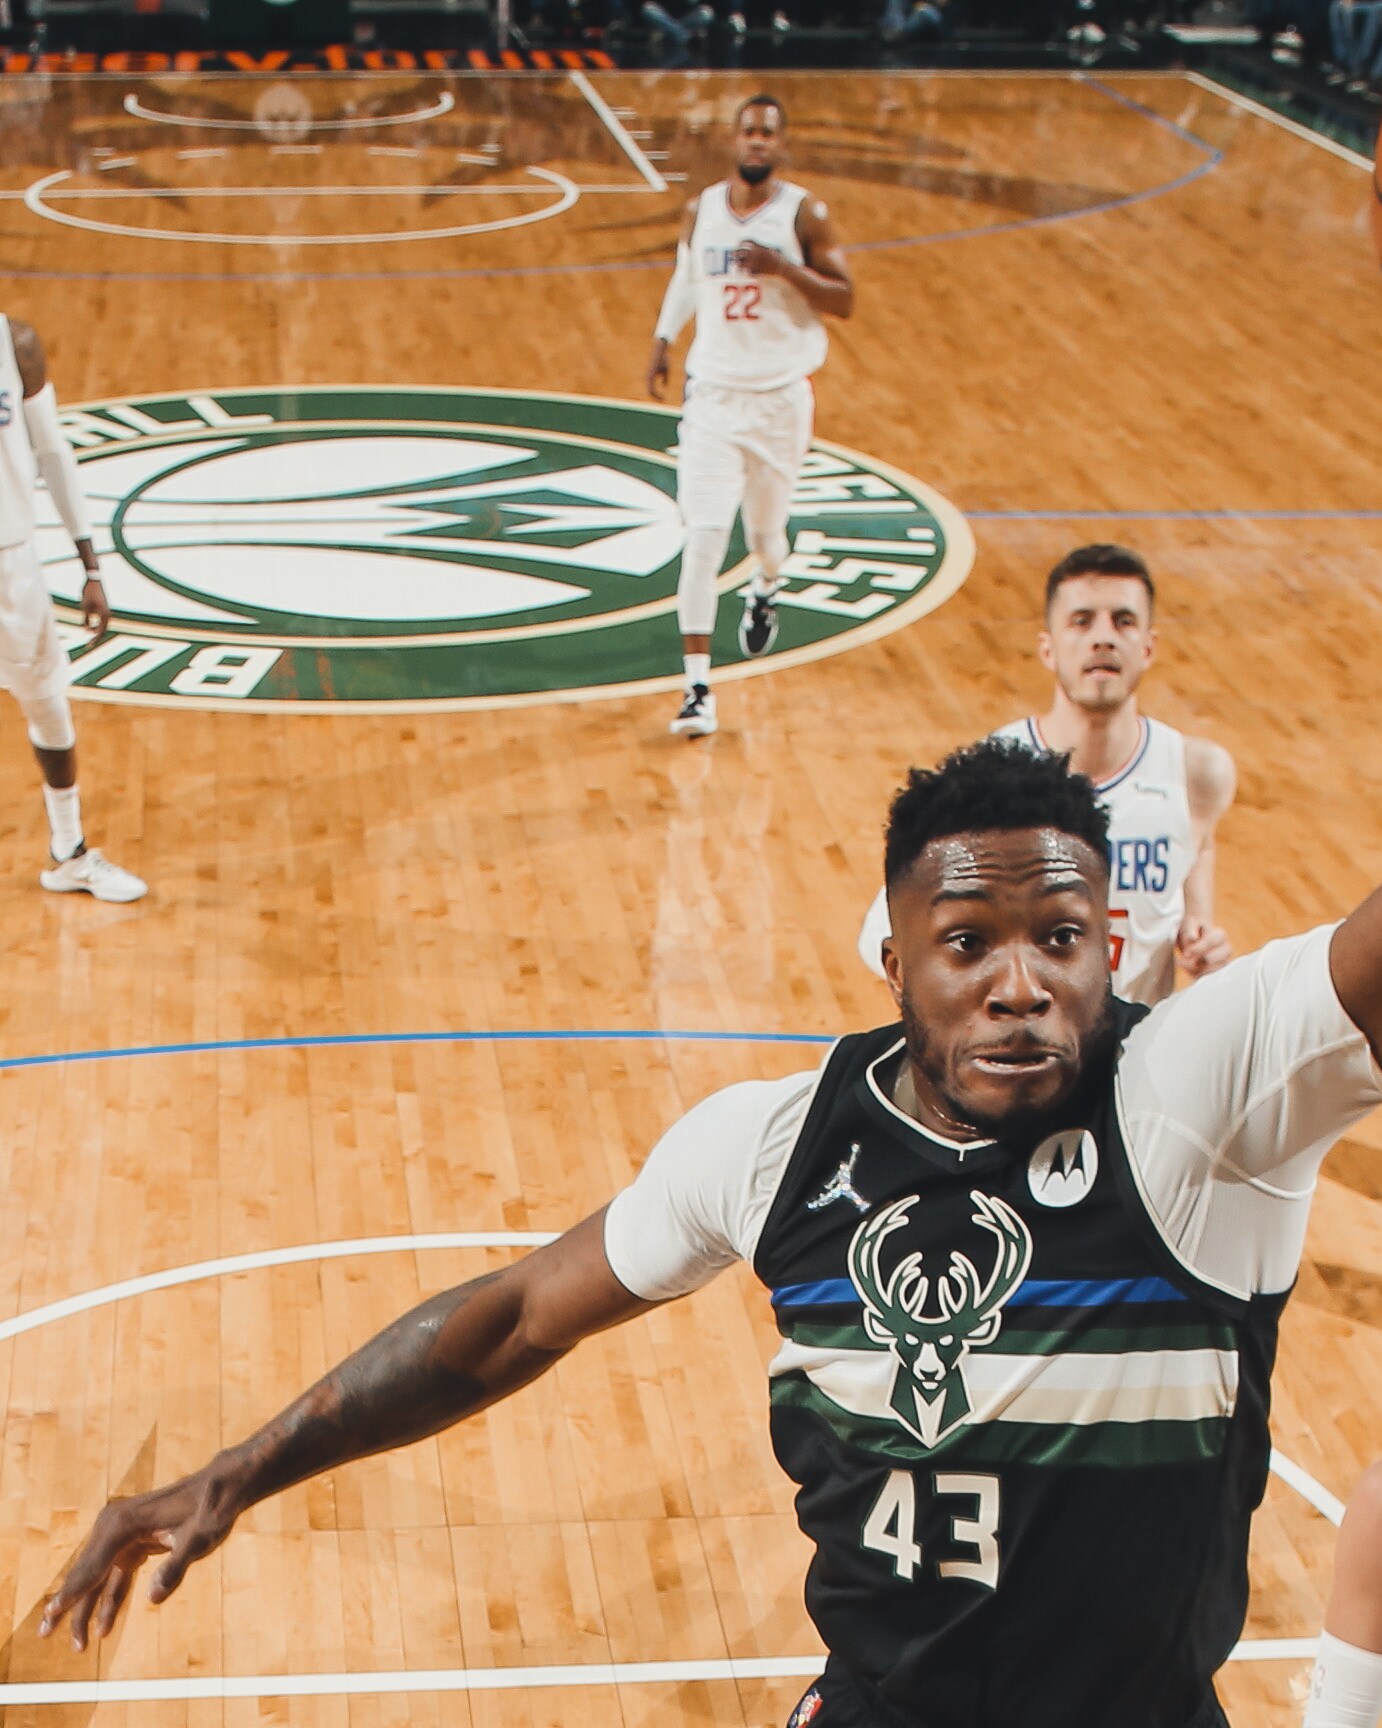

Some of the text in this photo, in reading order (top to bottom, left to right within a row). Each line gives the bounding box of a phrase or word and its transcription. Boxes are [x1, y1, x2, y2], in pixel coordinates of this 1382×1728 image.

[724, 284, 760, 320] 22
[1108, 837, 1169, 892] ERS
[861, 1469, 1000, 1591] 43
